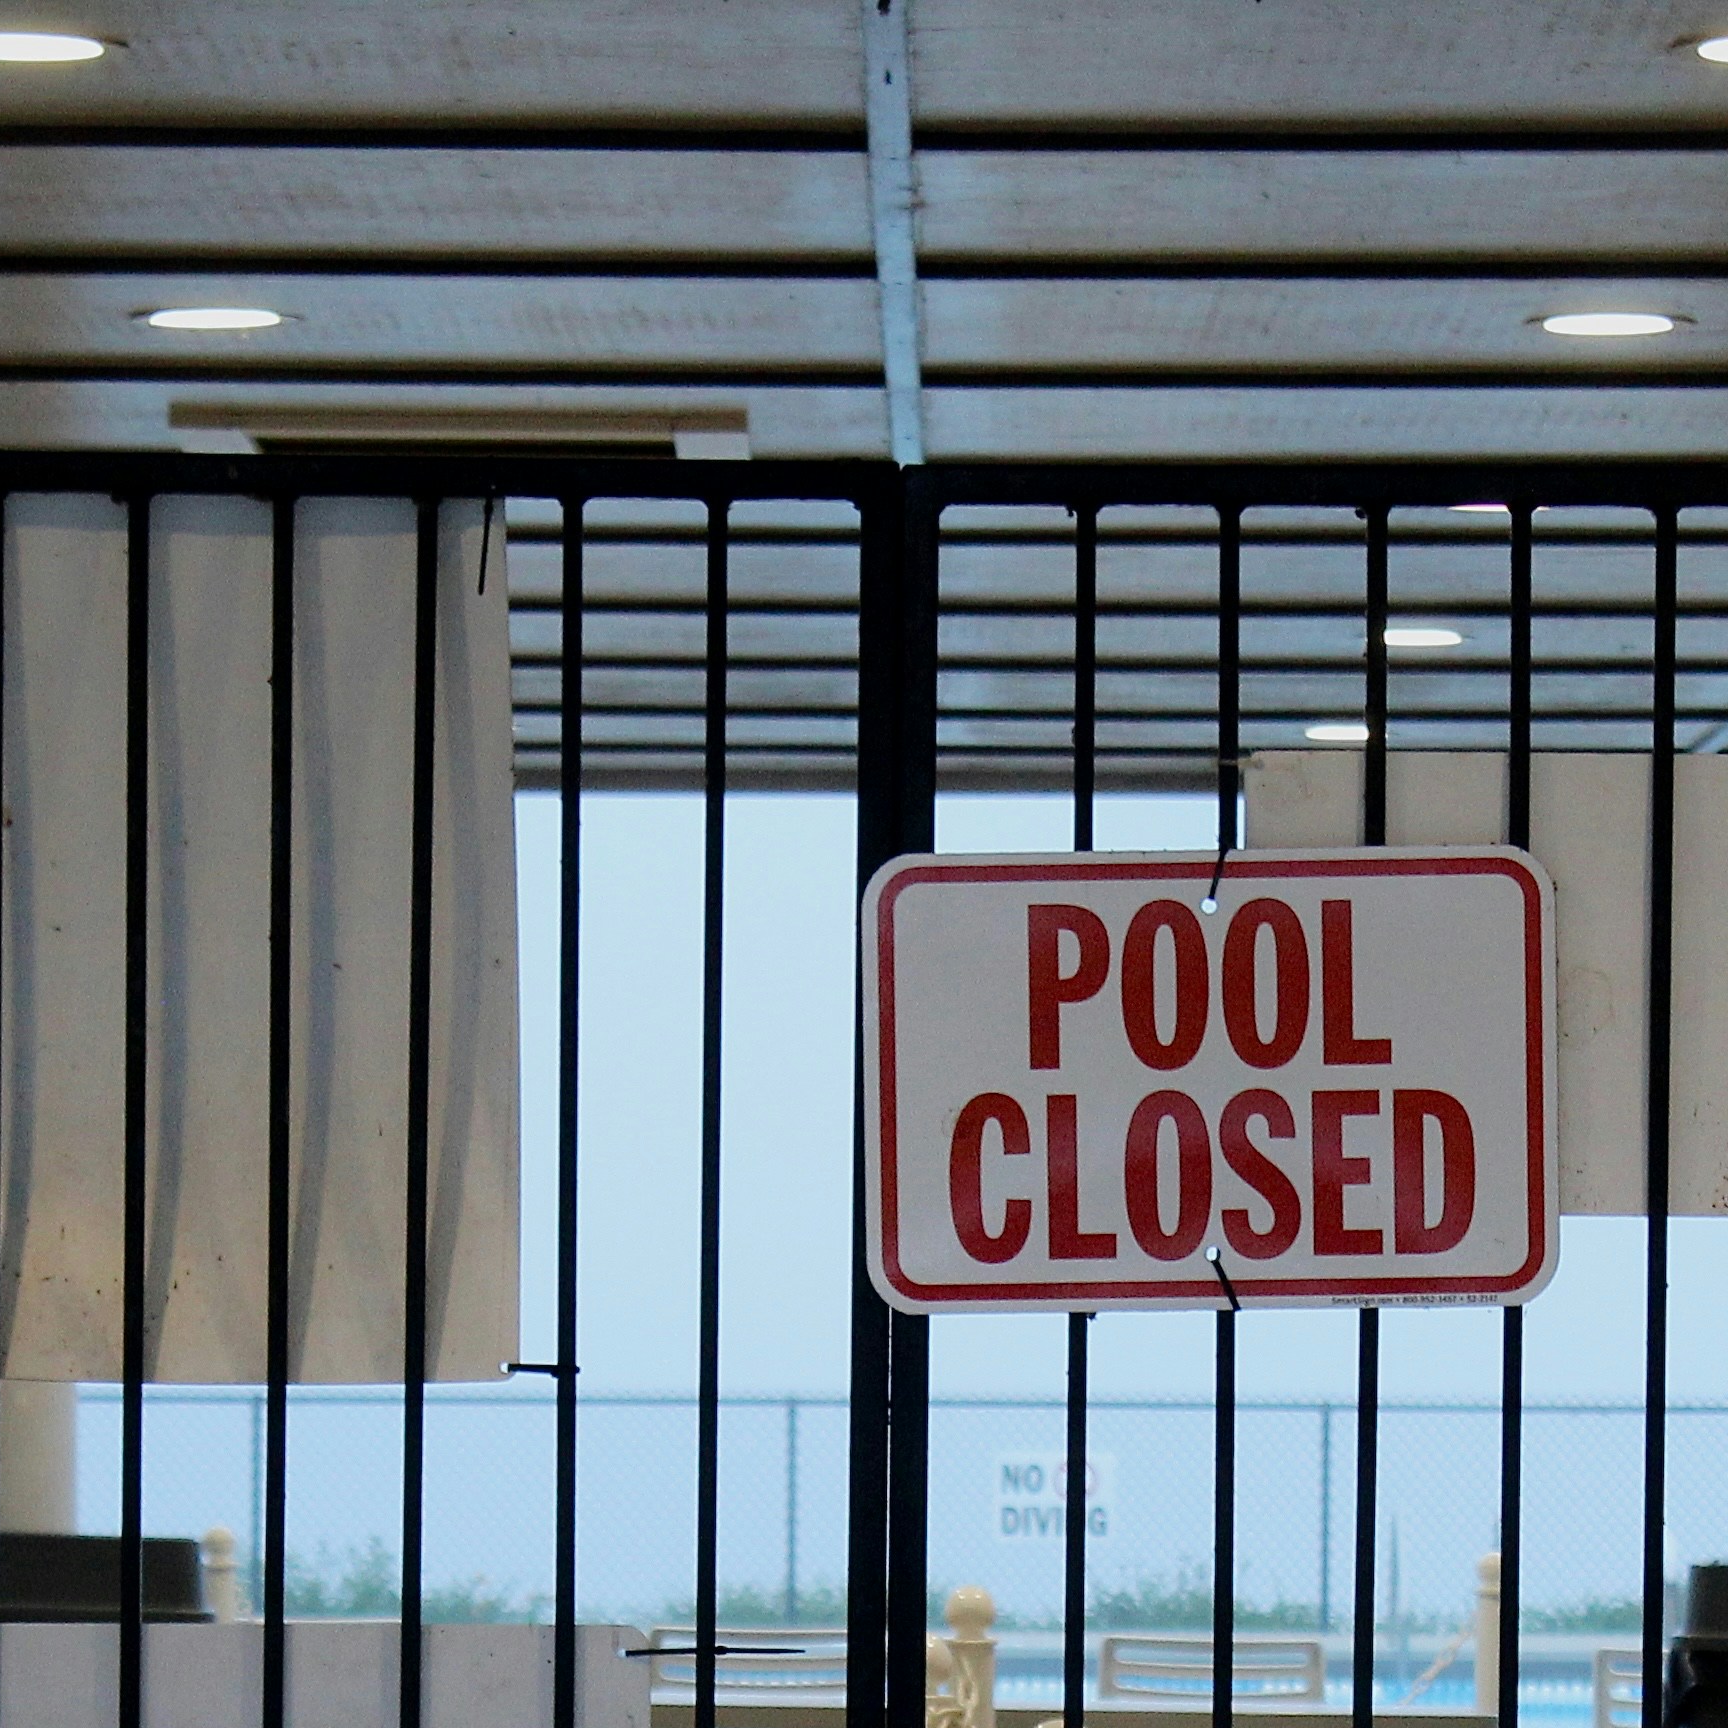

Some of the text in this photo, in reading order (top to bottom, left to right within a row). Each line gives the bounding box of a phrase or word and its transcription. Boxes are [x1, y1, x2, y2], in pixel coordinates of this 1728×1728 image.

[1028, 898, 1392, 1071] POOL
[949, 1089, 1475, 1264] CLOSED
[1001, 1464, 1044, 1494] NO
[1001, 1506, 1108, 1537] DIVIG
